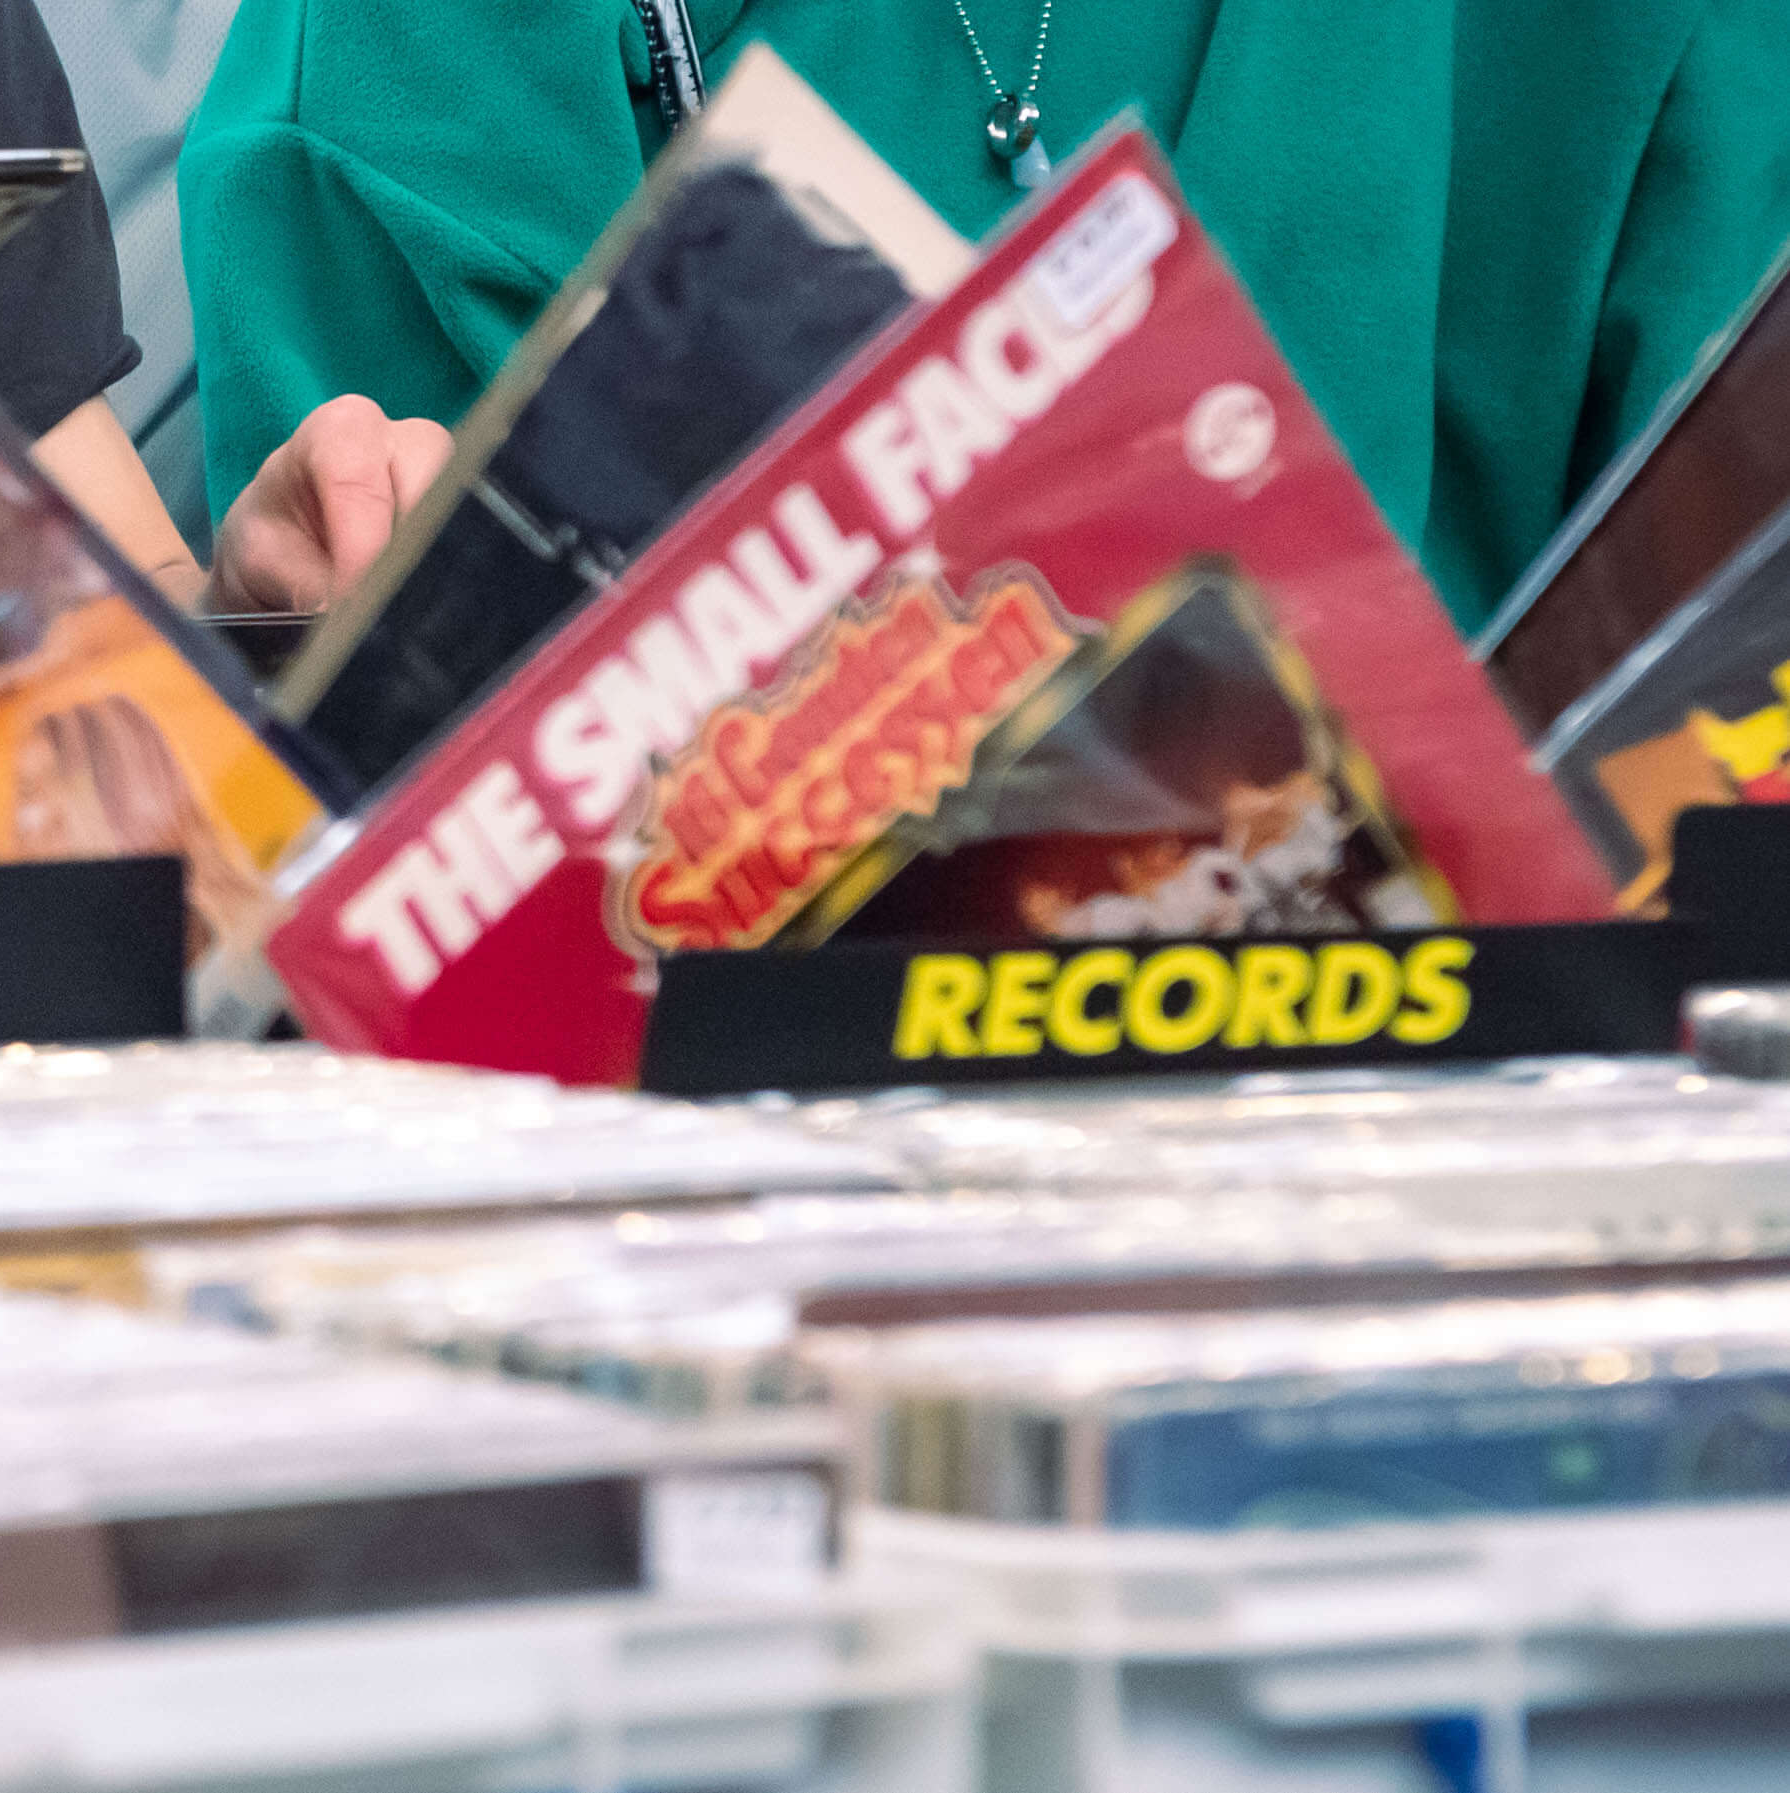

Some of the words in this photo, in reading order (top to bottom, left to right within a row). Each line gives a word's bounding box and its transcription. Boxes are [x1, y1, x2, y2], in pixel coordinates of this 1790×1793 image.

[340, 761, 567, 1000] THE
[532, 478, 887, 826] SMALL
[893, 936, 1477, 1061] RECORDS
